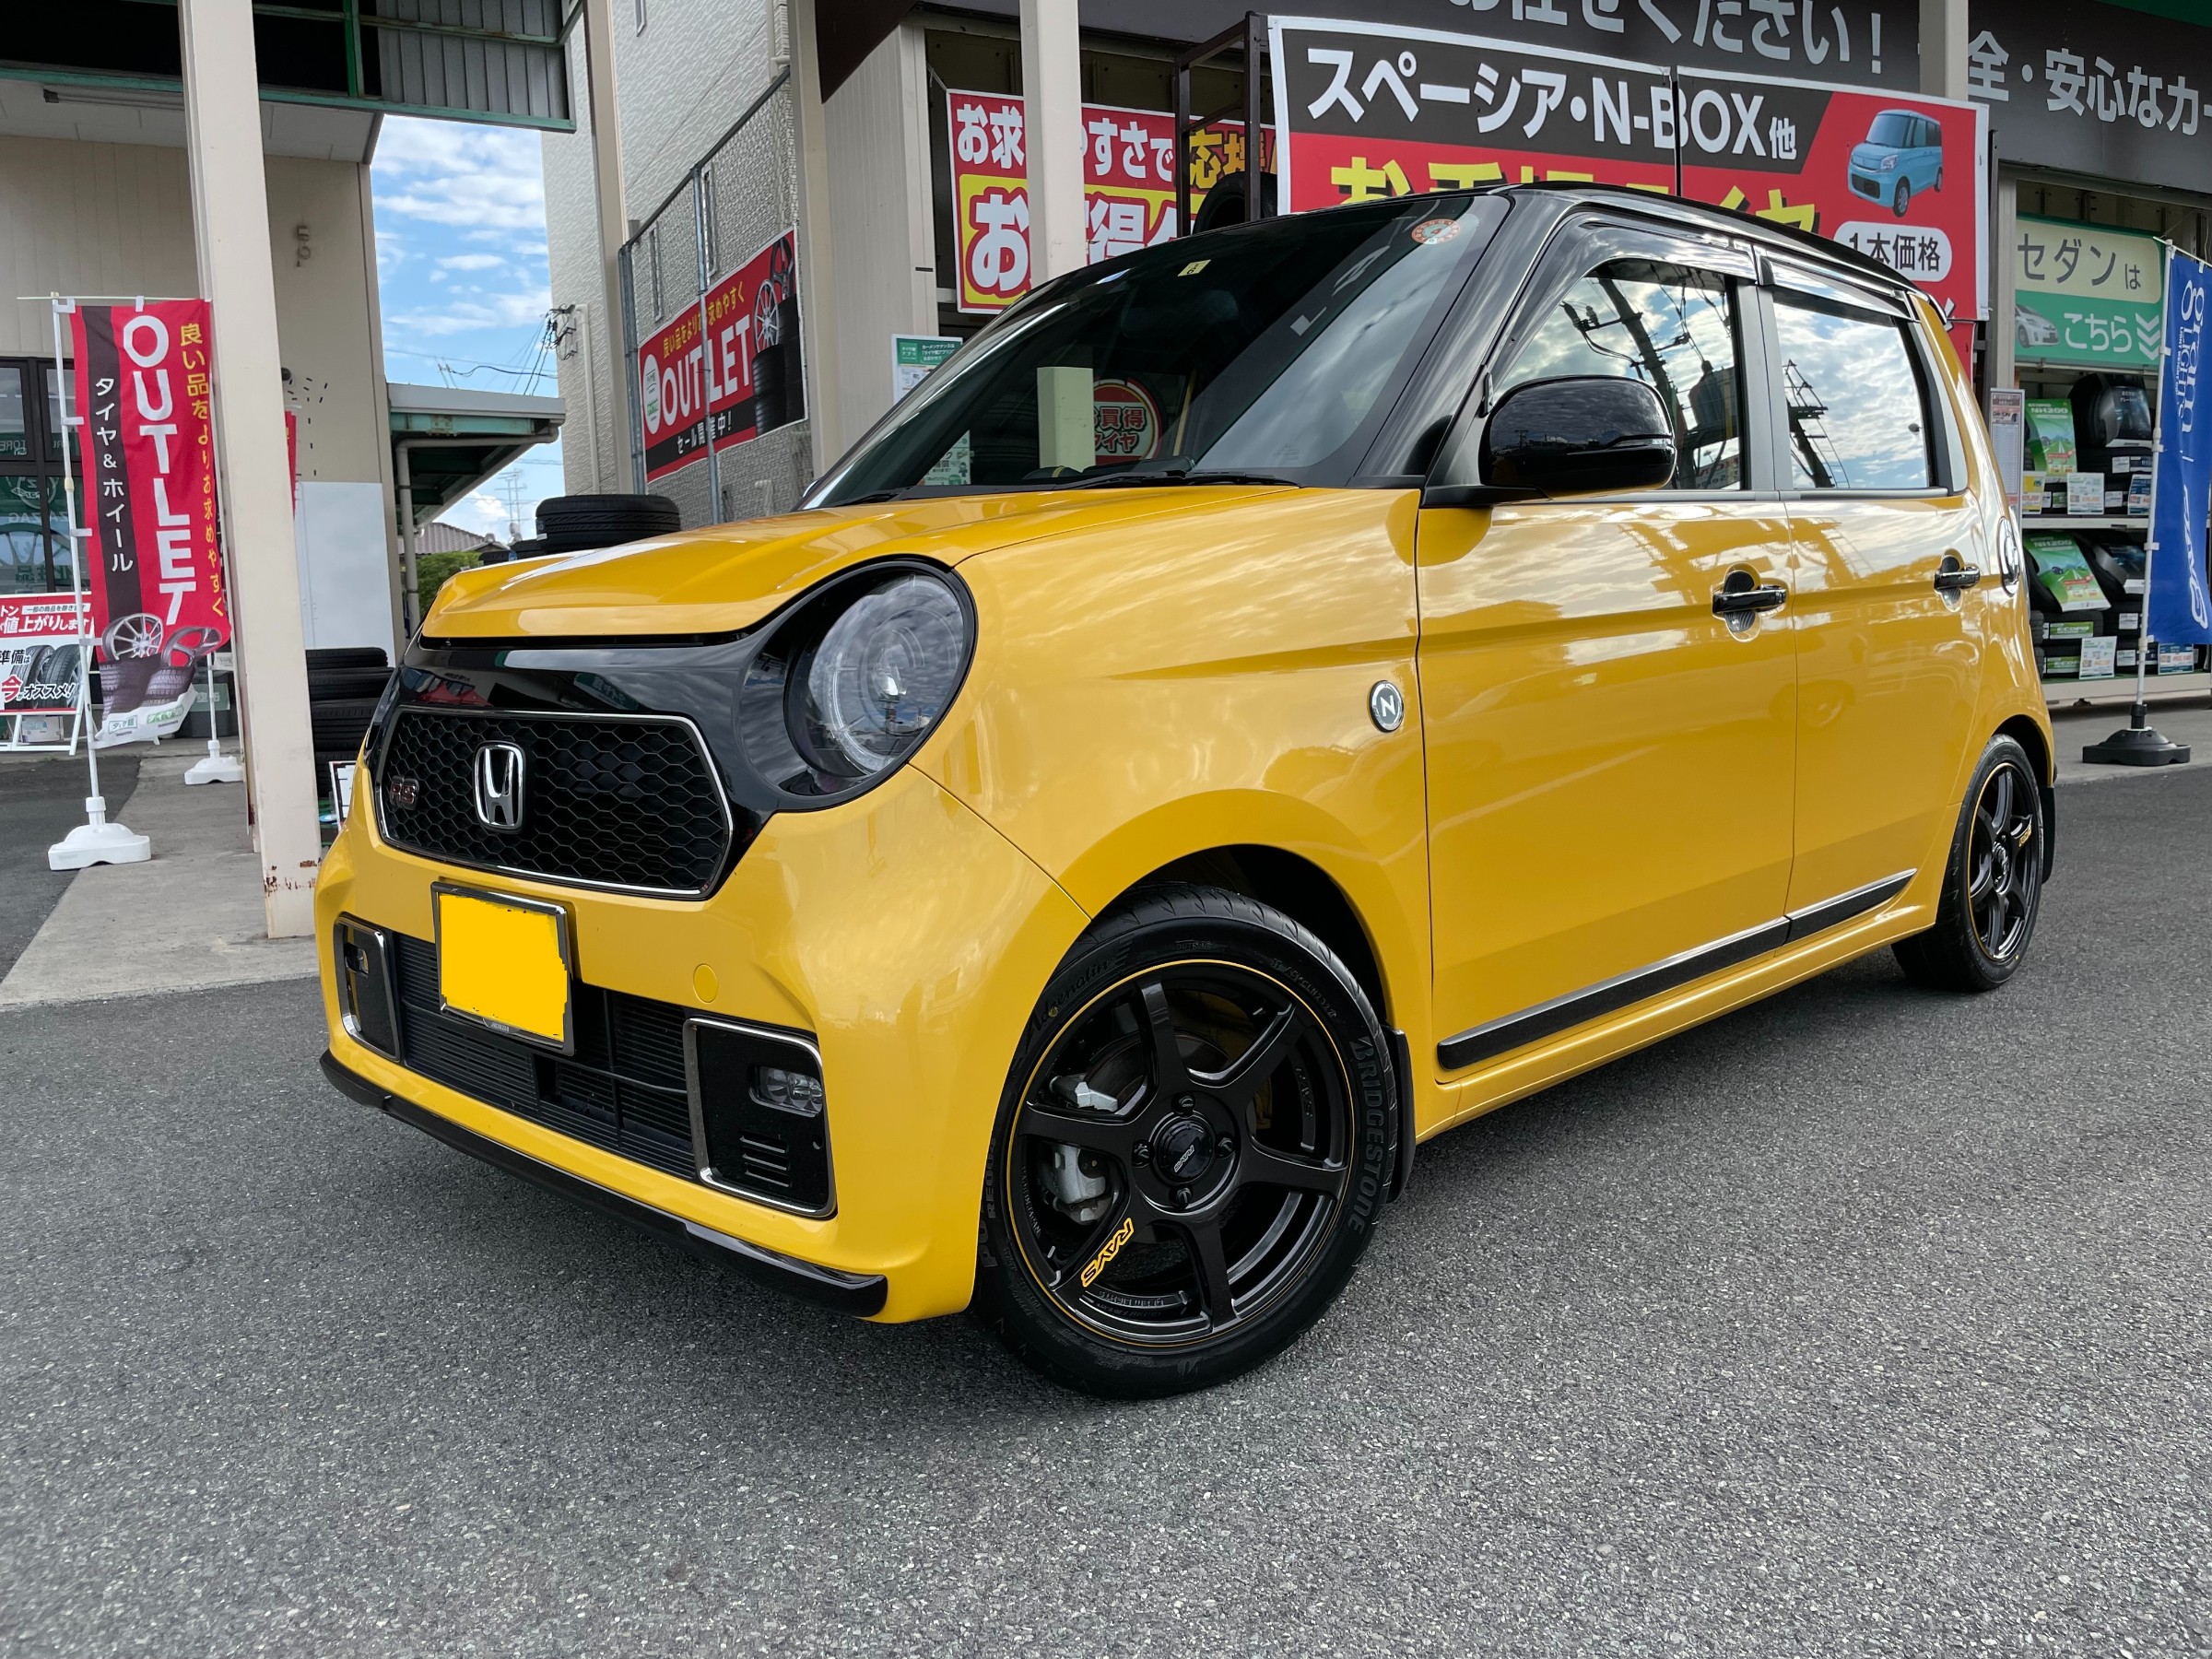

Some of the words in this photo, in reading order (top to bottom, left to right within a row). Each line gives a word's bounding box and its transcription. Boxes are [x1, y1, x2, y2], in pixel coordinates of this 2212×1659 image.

[1968, 30, 2212, 135] 全・安心なカ
[957, 103, 1174, 183] お求すさで
[1849, 232, 1940, 272] 1本価格
[2017, 233, 2142, 290] セダンは
[2063, 312, 2134, 353] こちら
[662, 314, 750, 427] OUTLET
[1094, 406, 1146, 430] 買得
[96, 378, 134, 572] タイヤ&ホイール
[124, 315, 197, 626] OUTLET
[181, 323, 224, 618] 良い品をよりお求めやすく
[0, 615, 89, 635] 値上がりしま
[1380, 695, 1396, 717] N
[1174, 1145, 1195, 1173] RAYS
[1349, 1036, 1384, 1235] BRIDGESTONE
[1081, 1218, 1135, 1288] RAYS
